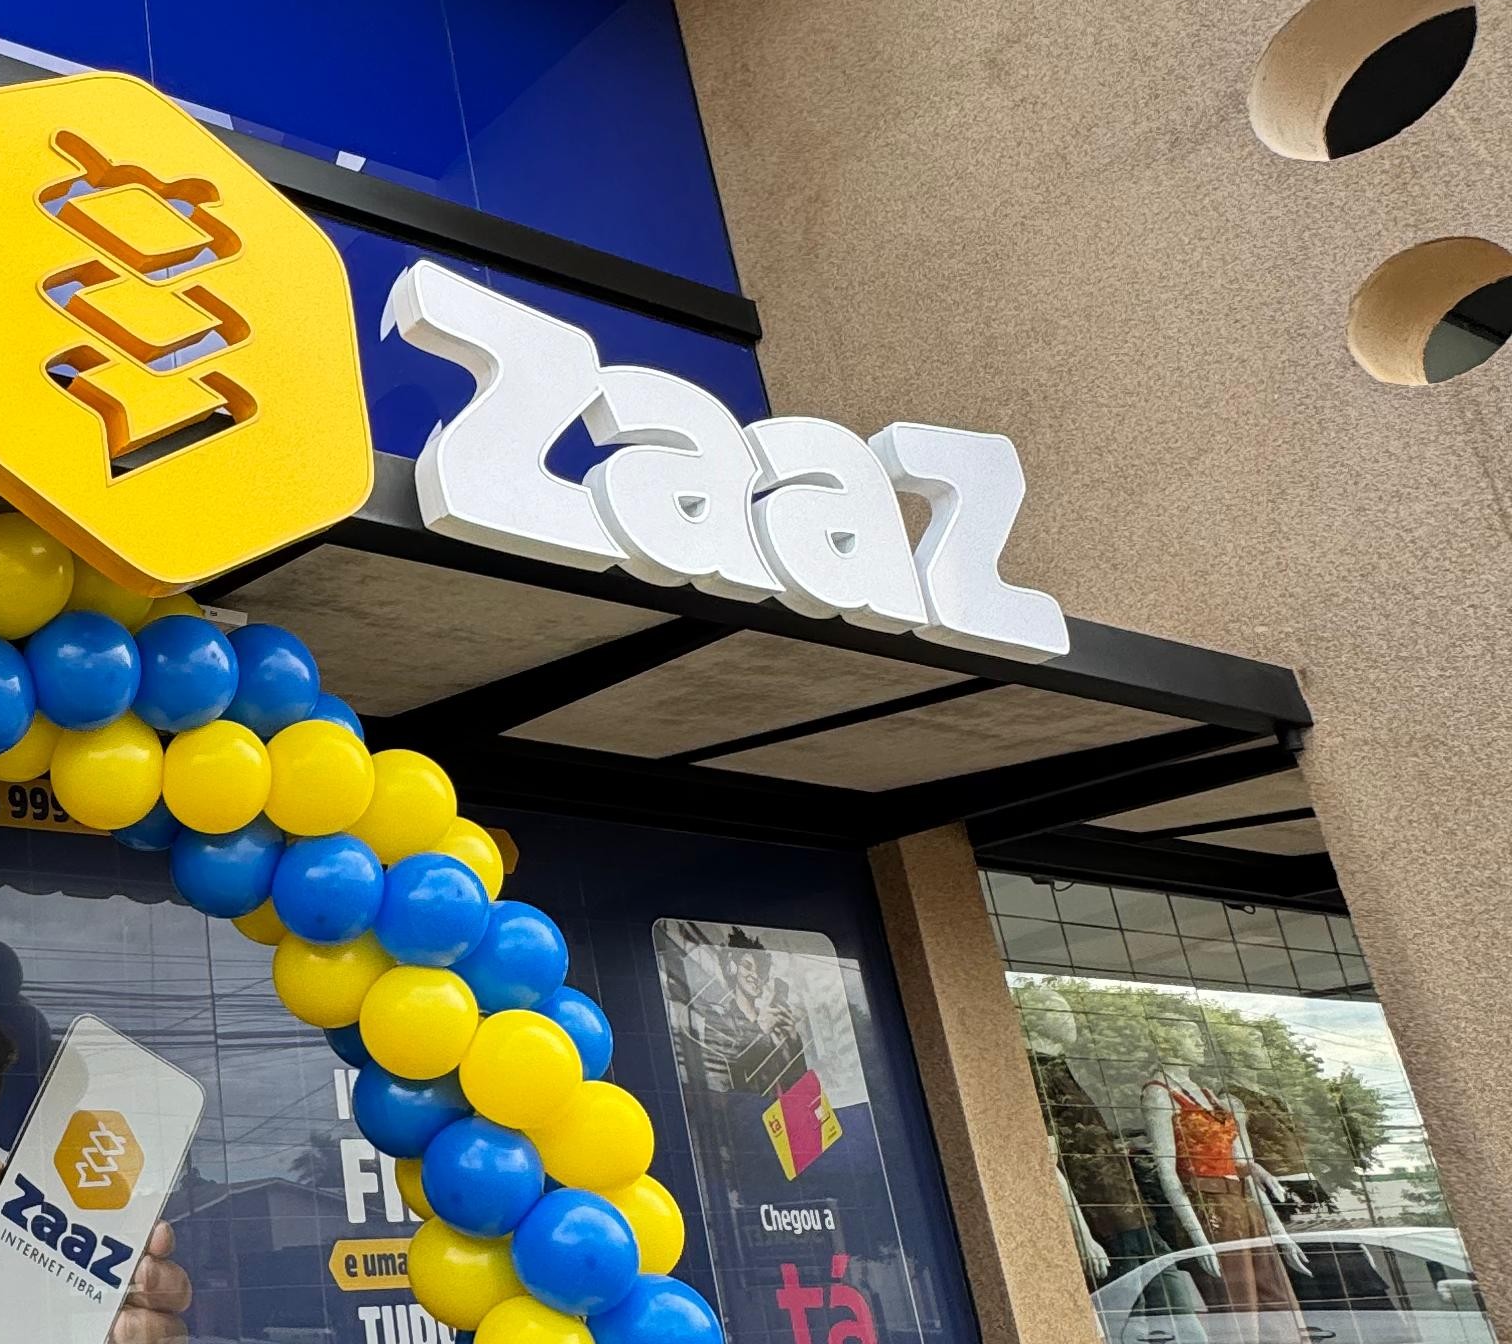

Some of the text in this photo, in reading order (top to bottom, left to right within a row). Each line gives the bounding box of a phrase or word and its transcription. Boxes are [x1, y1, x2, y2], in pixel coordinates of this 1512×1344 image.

[340, 1138, 425, 1224] FI
[760, 1204, 836, 1236] Chegou a
[0, 1228, 103, 1305] INTERNET FIBRA
[344, 1251, 408, 1278] e uma
